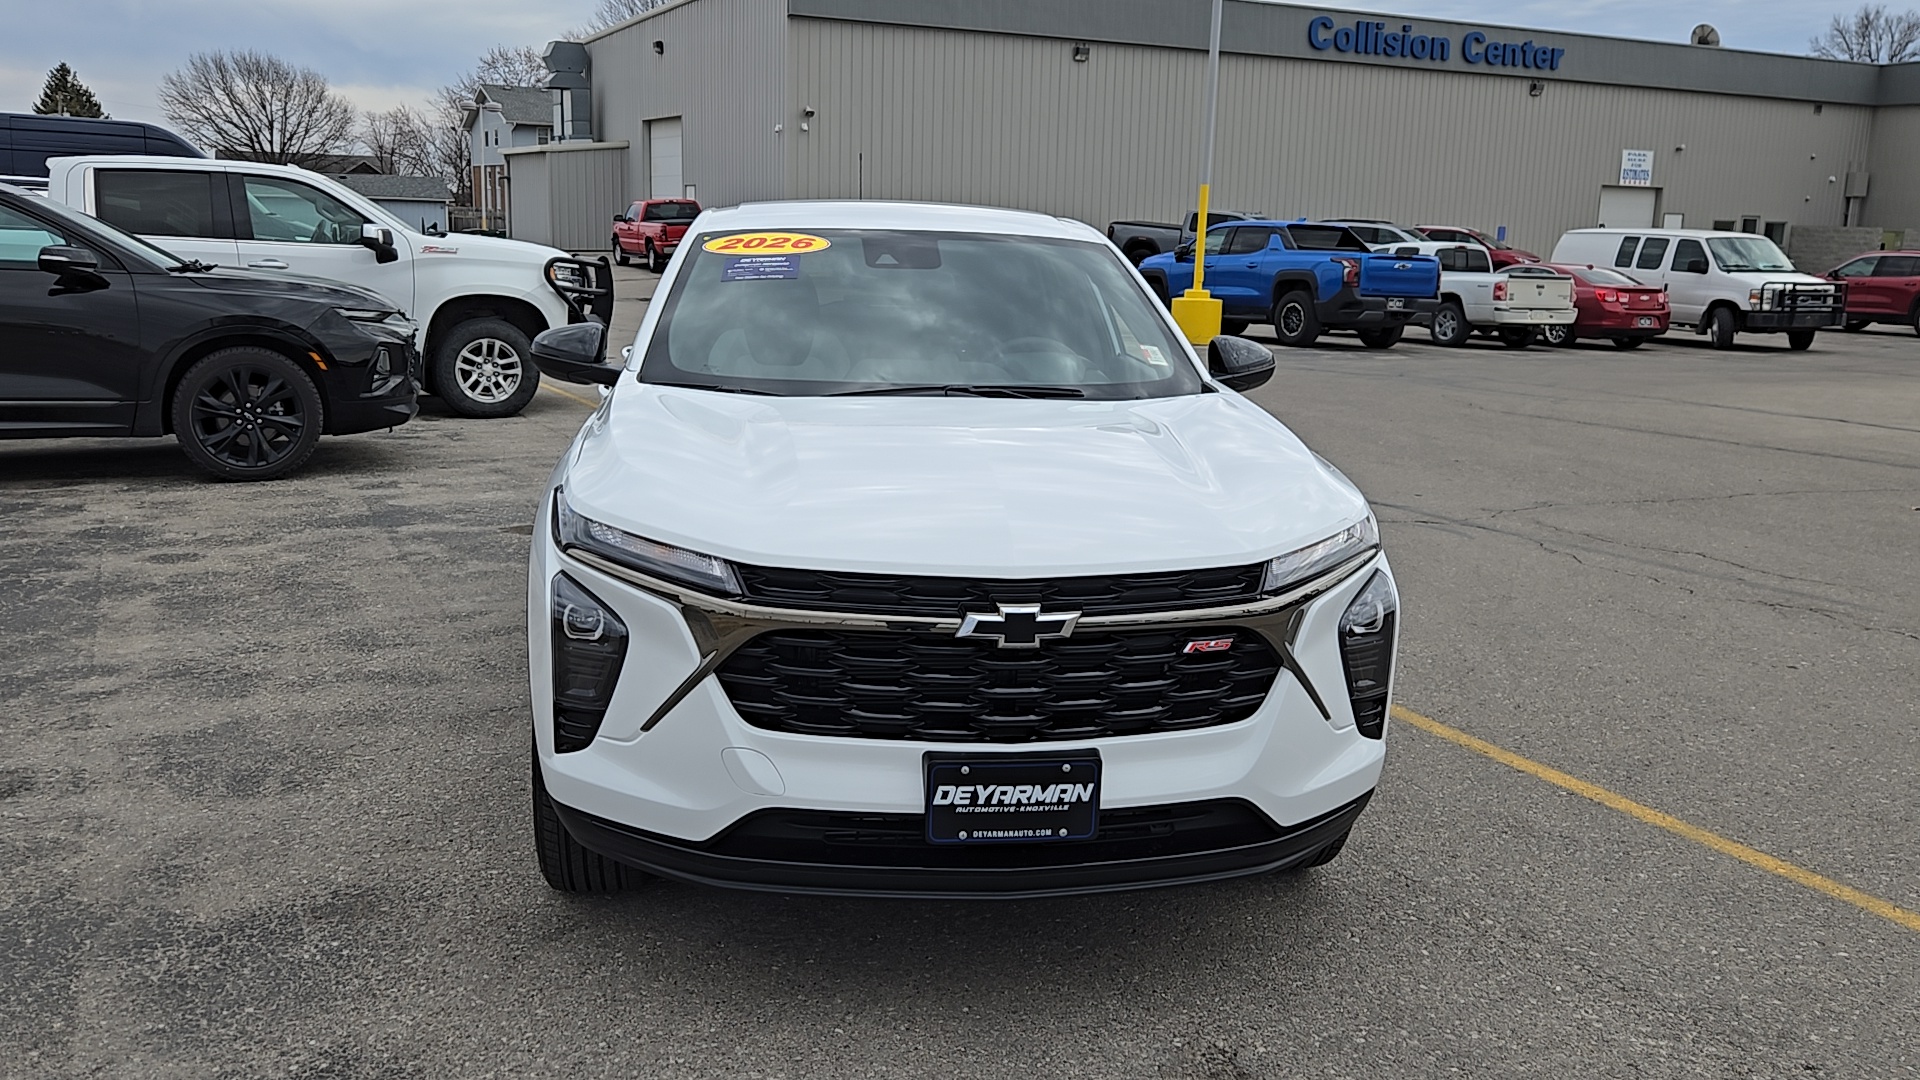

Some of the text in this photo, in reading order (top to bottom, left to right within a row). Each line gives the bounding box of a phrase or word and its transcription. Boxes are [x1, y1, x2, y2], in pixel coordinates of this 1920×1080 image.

[1308, 16, 1565, 71] Collision Center
[716, 237, 817, 251] 2026
[1183, 638, 1234, 654] RS
[932, 783, 1095, 806] DEYARMAN
[973, 829, 1052, 838] DEYARMANAUTO.COM
